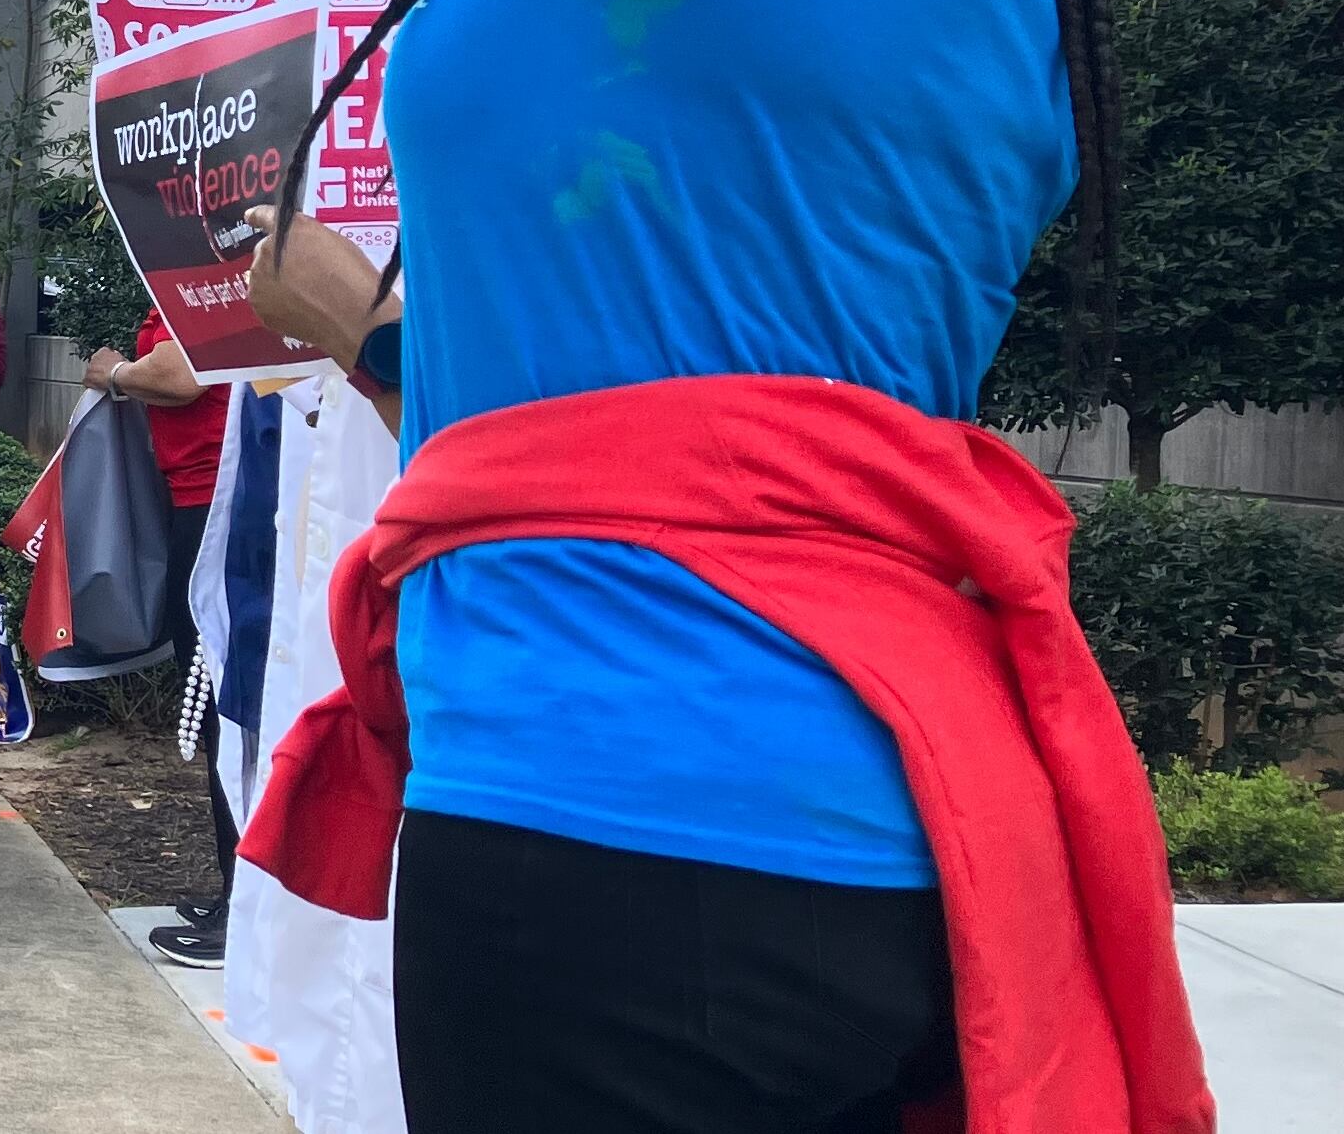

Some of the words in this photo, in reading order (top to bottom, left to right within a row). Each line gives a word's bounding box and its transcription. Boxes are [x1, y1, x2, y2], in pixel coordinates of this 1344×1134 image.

[114, 88, 258, 166] workplace
[352, 164, 389, 179] Nati
[353, 193, 399, 207] Unite
